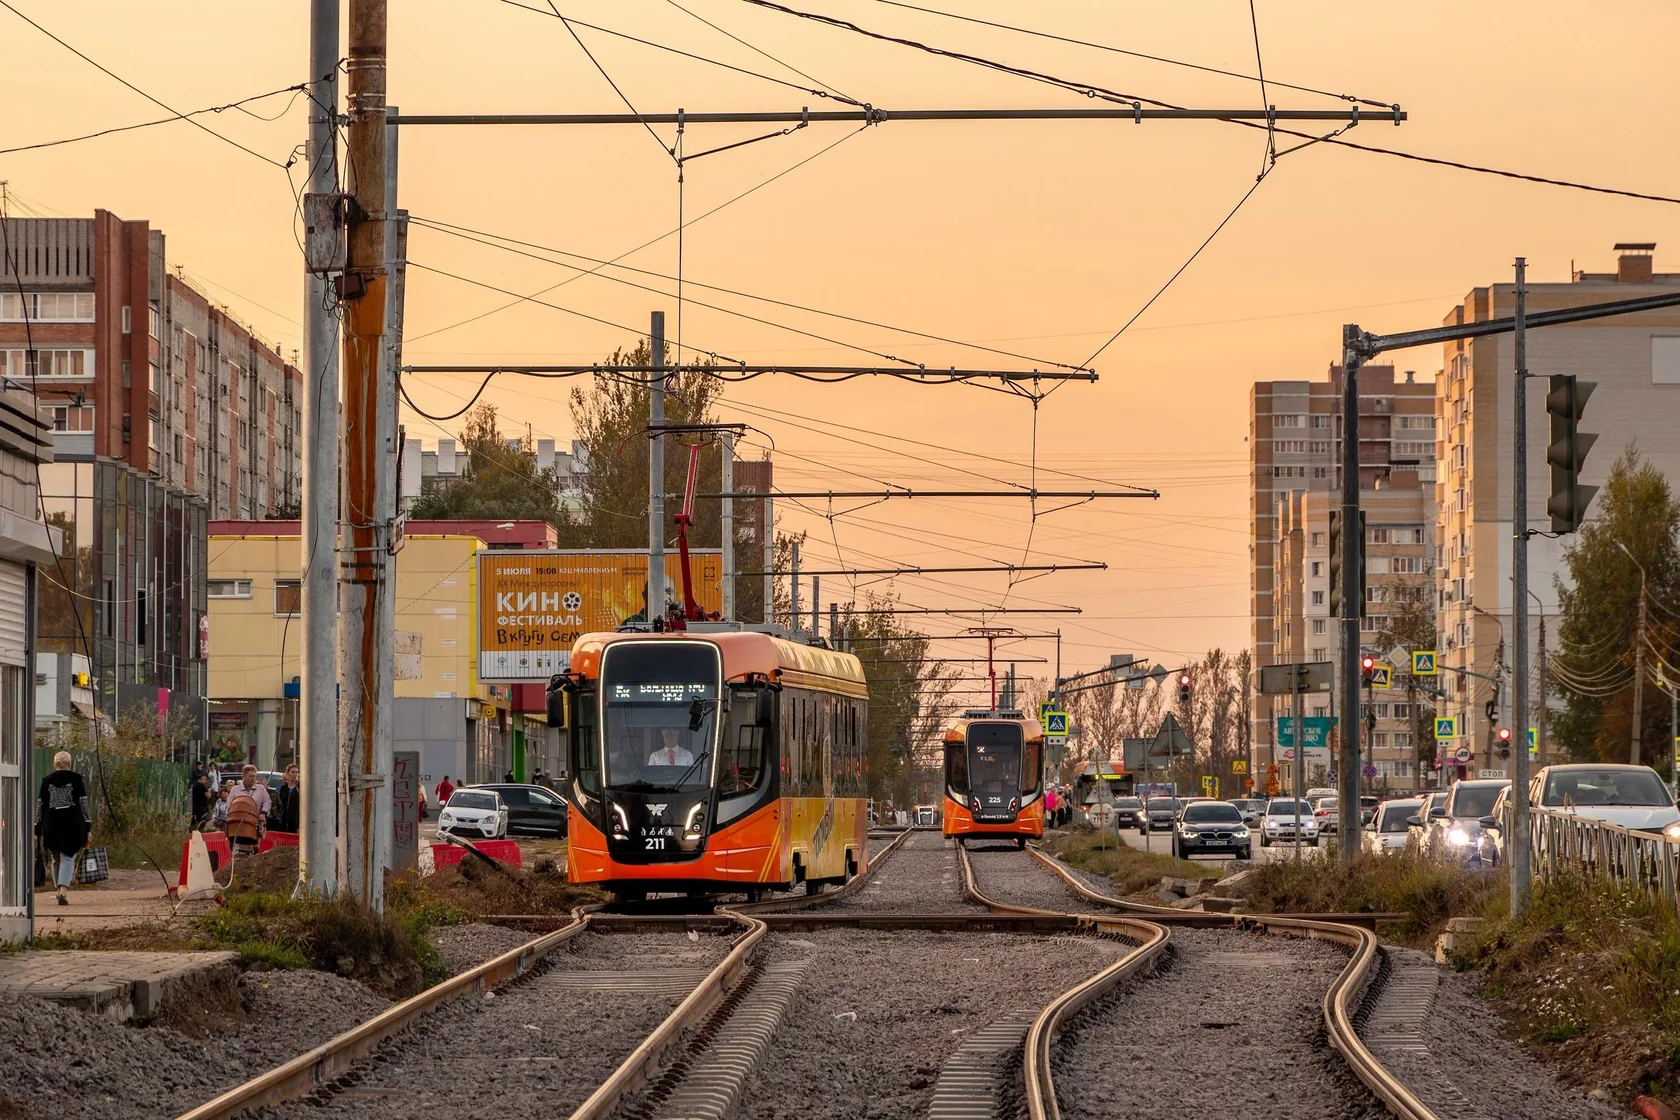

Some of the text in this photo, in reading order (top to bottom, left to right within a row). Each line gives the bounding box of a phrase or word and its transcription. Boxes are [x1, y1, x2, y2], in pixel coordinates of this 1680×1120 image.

[535, 567, 556, 575] 15:00
[510, 580, 580, 588] Международный
[497, 615, 582, 626] ФЕСТИВАЛЬ
[497, 629, 507, 644] В
[551, 630, 583, 643] СЕМ
[1481, 770, 1504, 778] СТОП
[645, 838, 665, 850] 211
